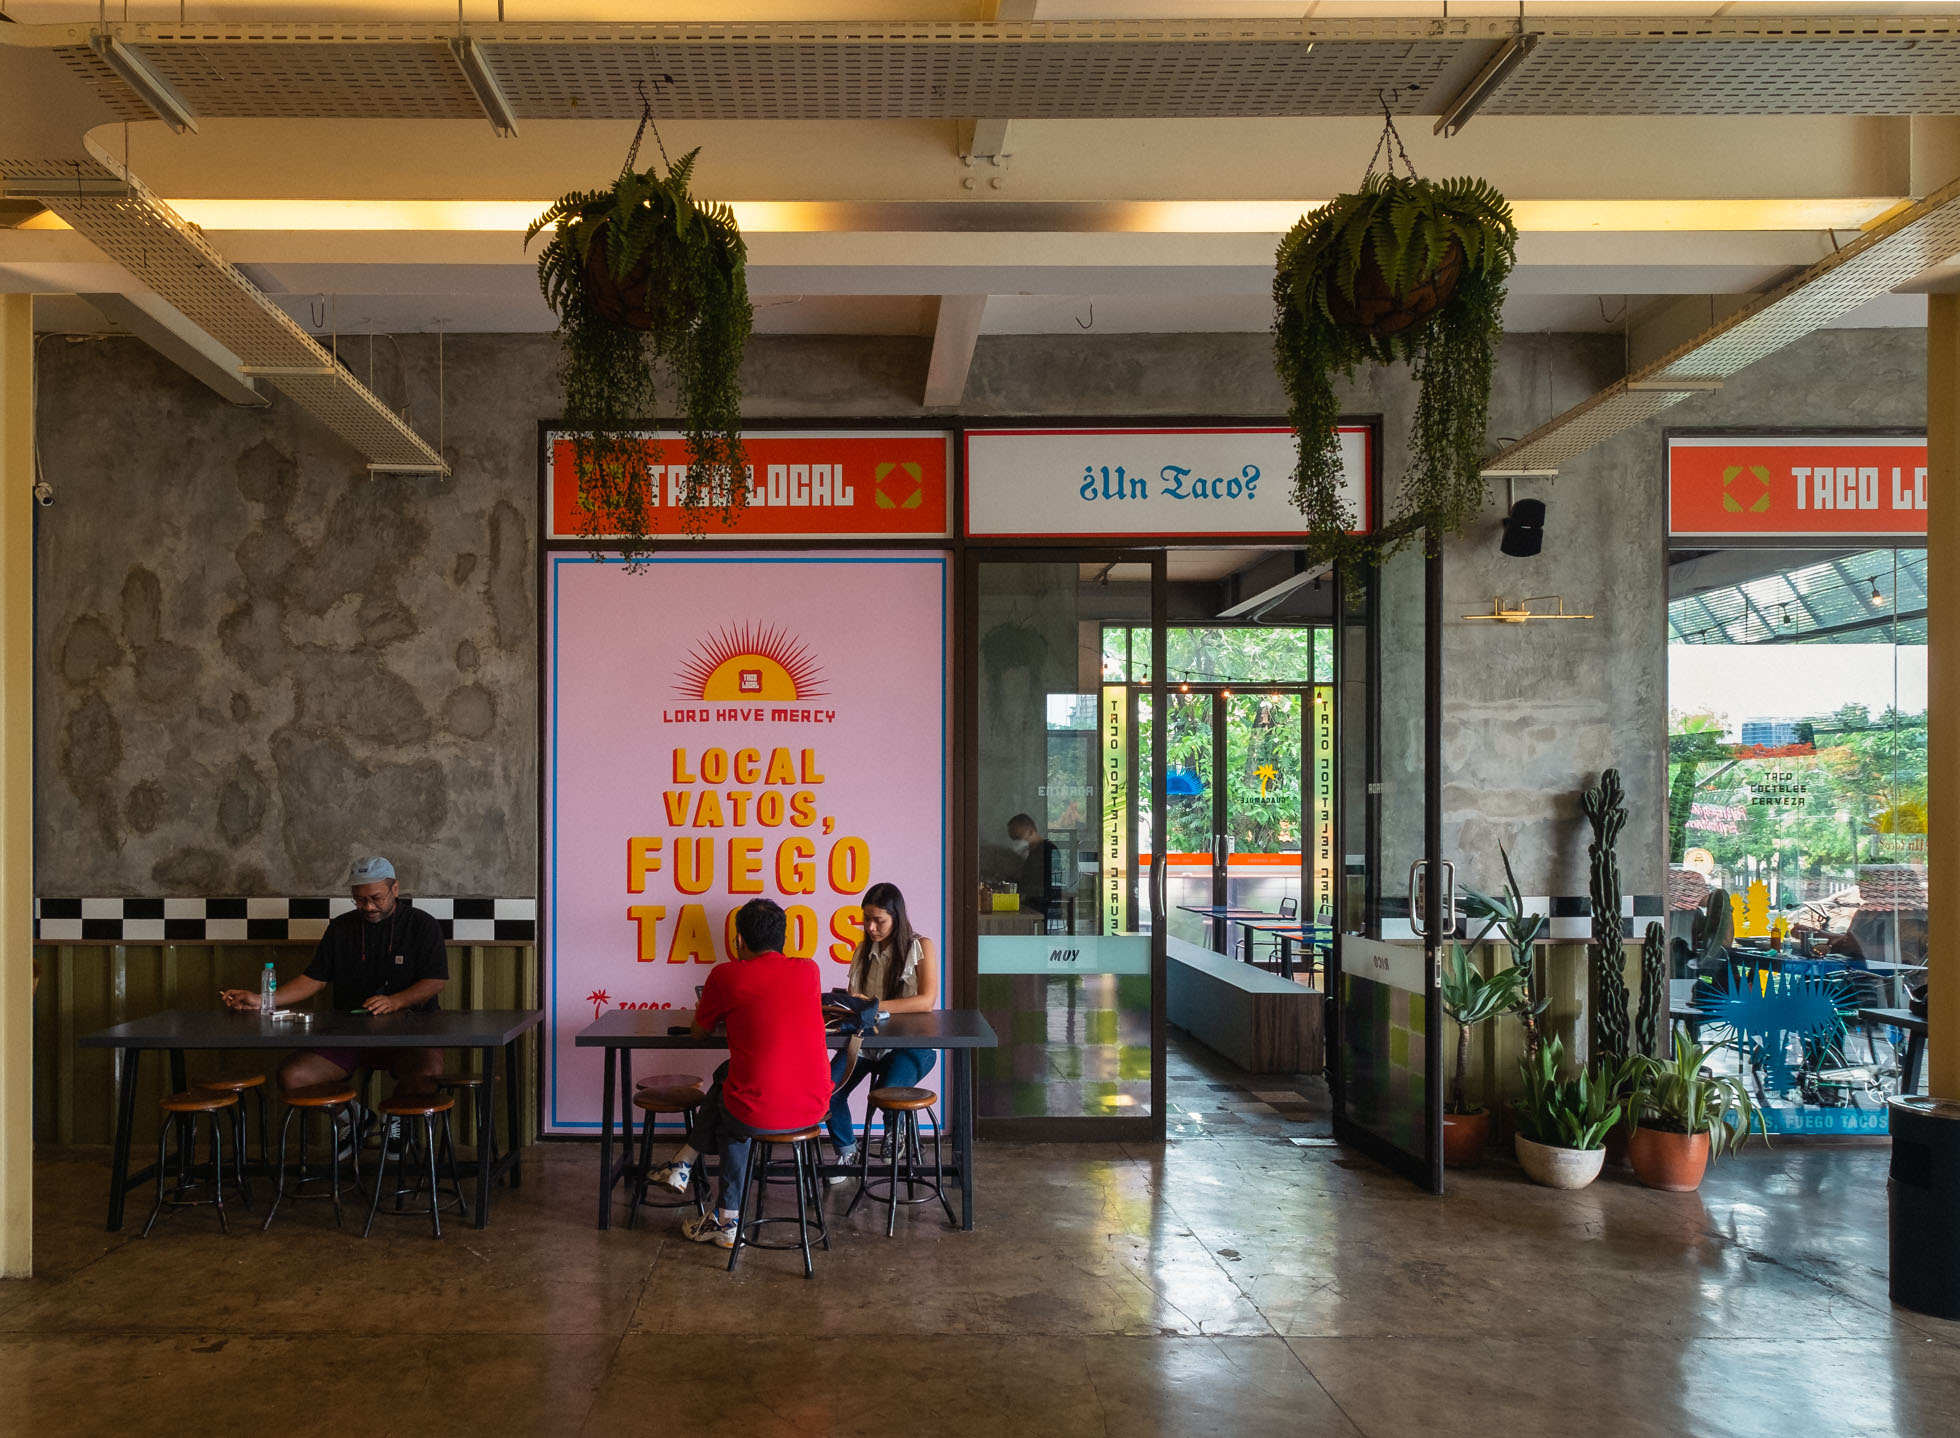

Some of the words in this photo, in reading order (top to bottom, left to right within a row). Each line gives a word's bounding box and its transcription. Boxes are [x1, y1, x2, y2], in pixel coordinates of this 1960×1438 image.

[745, 464, 854, 507] LOCAL
[1080, 465, 1148, 501] ¿Un
[1160, 464, 1261, 500] Taco?
[1791, 466, 1879, 510] TACO
[663, 709, 710, 724] LORD
[716, 708, 765, 723] HAVE
[771, 708, 836, 724] MERCY
[672, 747, 826, 786] LOCAL
[1764, 772, 1793, 781] TACO
[1750, 784, 1807, 793] COCTELES
[1751, 797, 1805, 806] CERVEZA
[662, 790, 836, 836] VATOS,
[627, 836, 871, 896] FUEGO
[1049, 949, 1080, 962] MUY
[1785, 1115, 1833, 1129] FUEGO
[1841, 1114, 1888, 1129] TACOS
